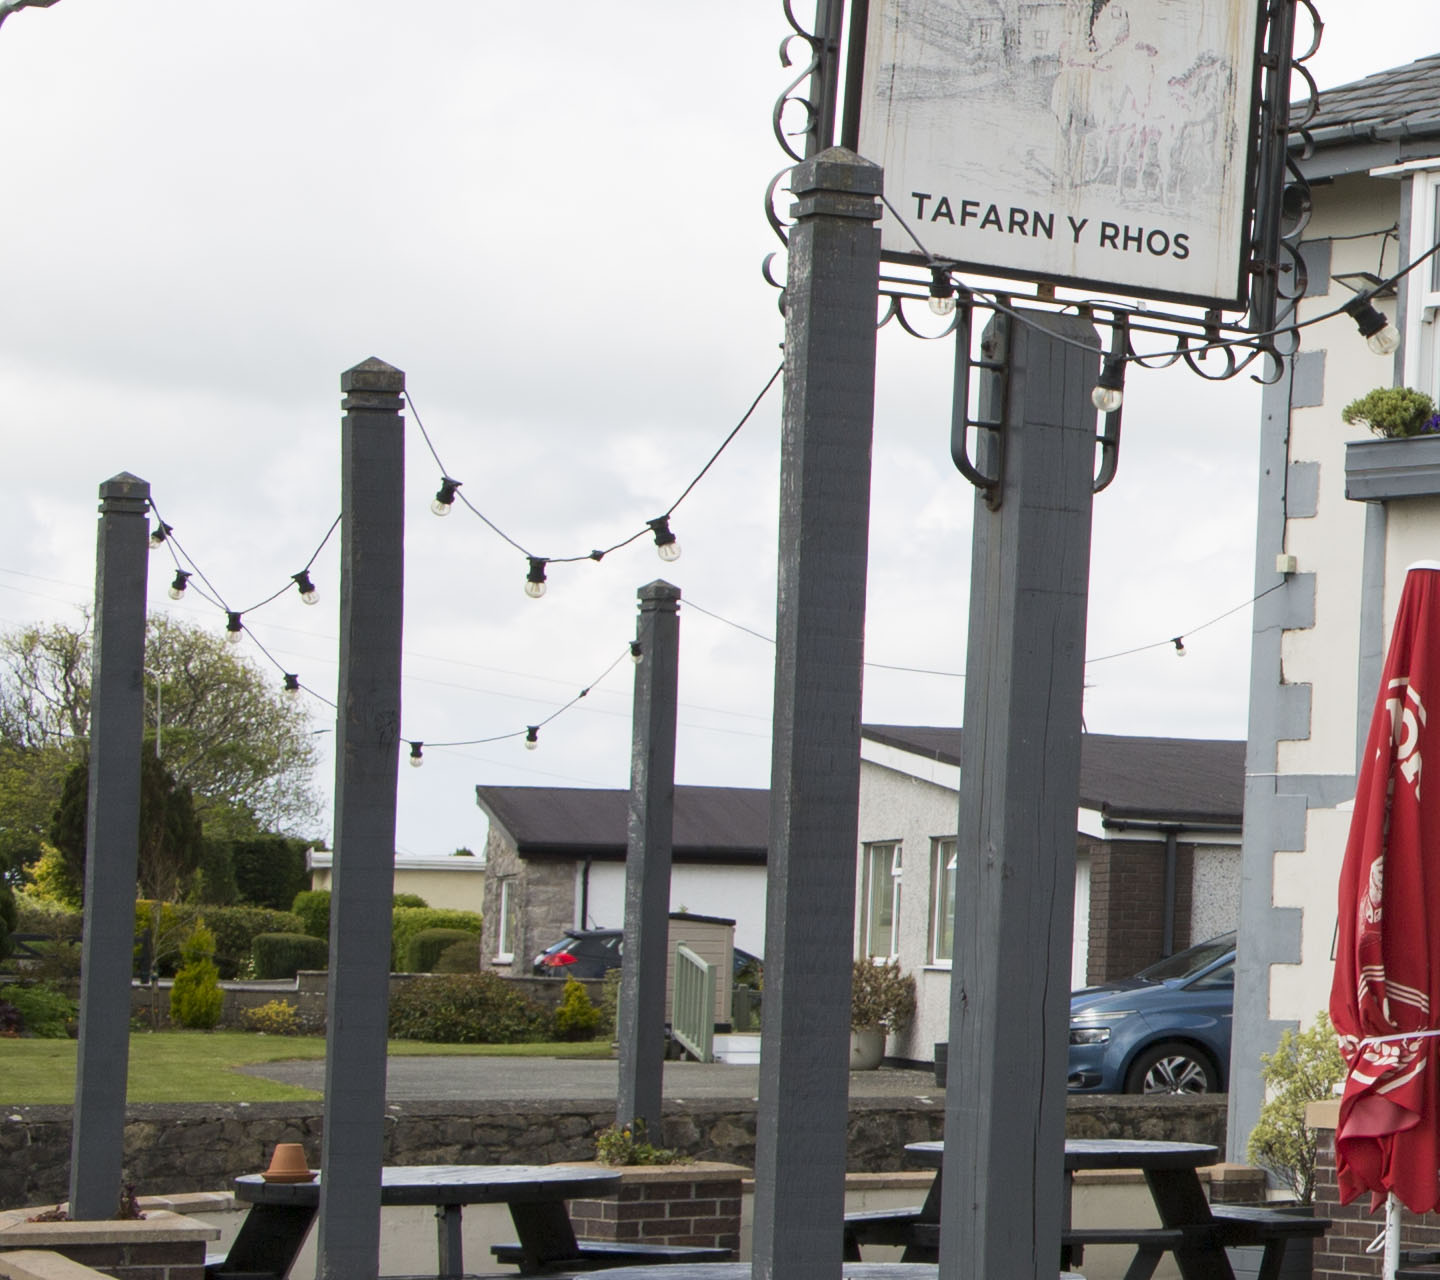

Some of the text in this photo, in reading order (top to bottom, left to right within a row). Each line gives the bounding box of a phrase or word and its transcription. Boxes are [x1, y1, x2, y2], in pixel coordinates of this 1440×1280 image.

[911, 191, 1190, 260] TAFARN Y RHOS
